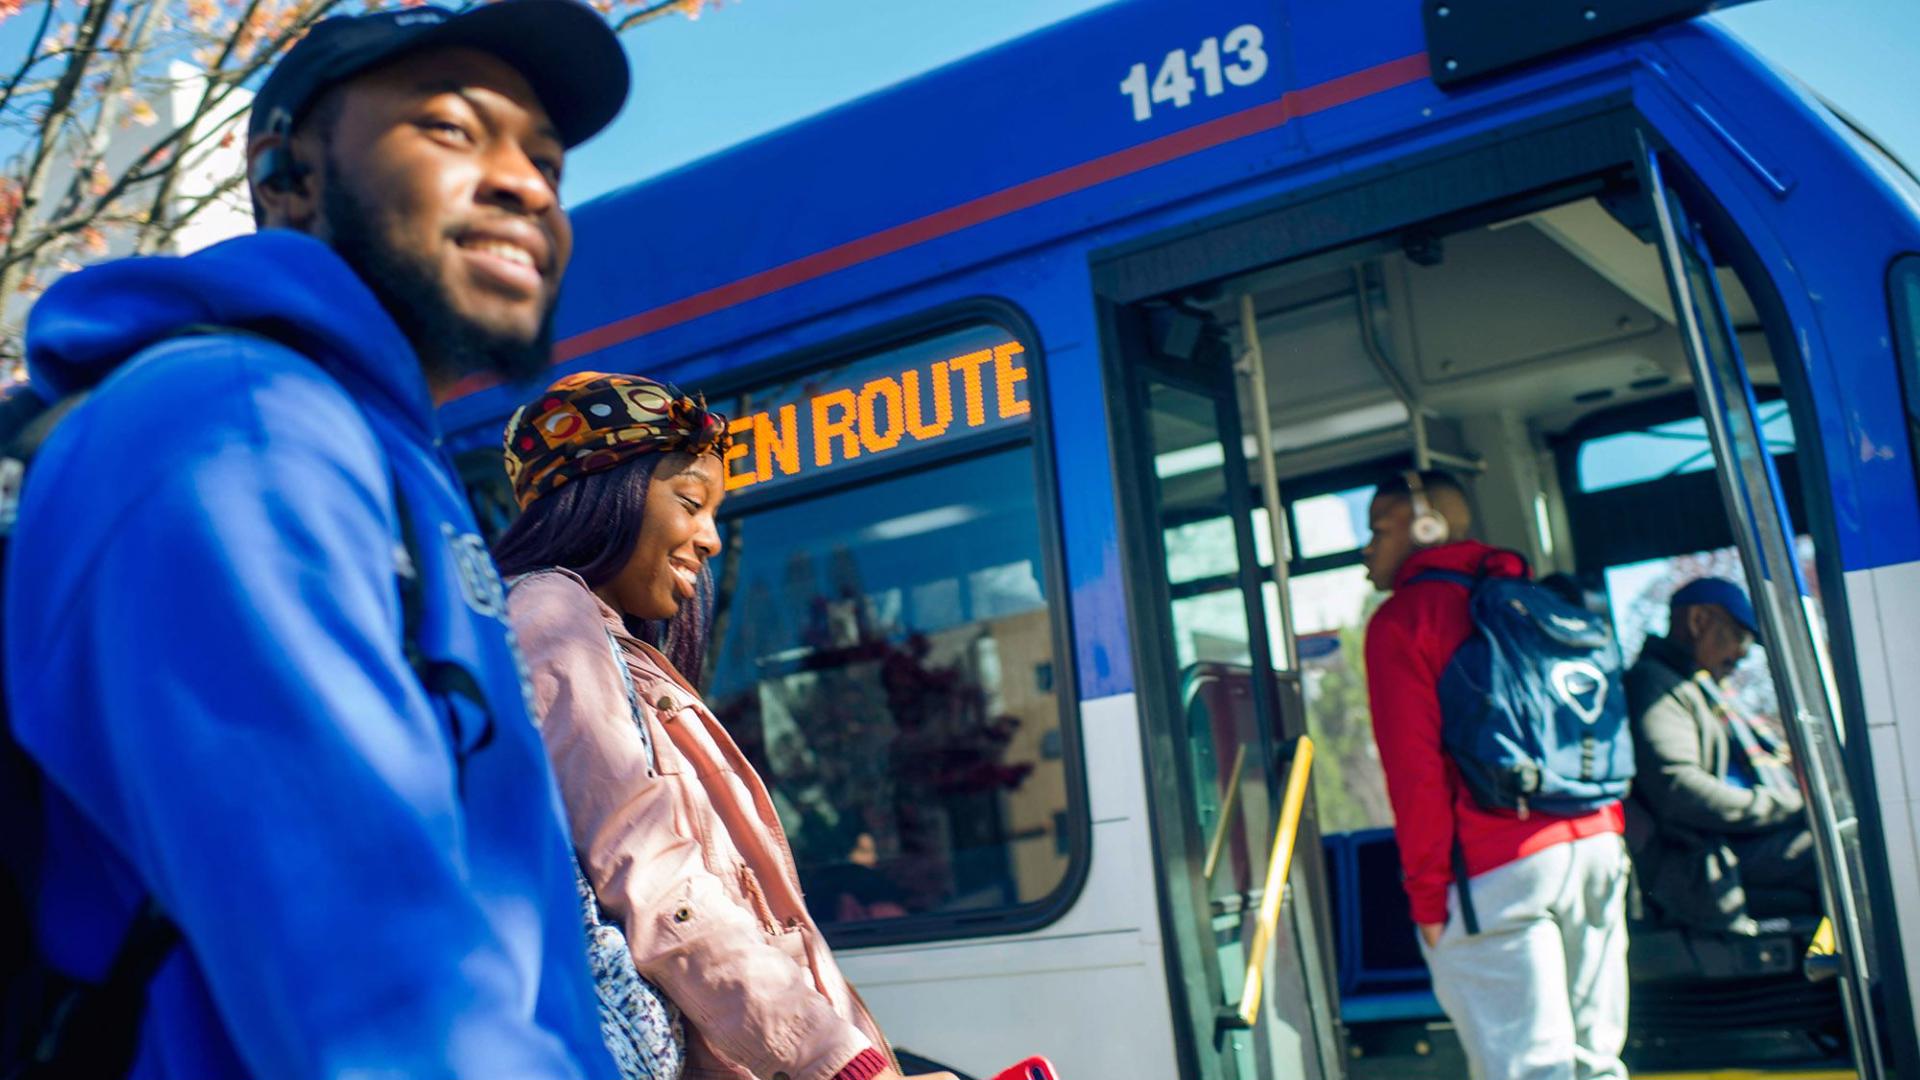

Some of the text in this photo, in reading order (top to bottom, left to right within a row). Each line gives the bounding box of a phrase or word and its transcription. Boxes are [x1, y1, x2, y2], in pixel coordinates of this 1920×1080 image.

[1120, 24, 1268, 121] 1413
[724, 341, 1030, 491] EN ROUTE
